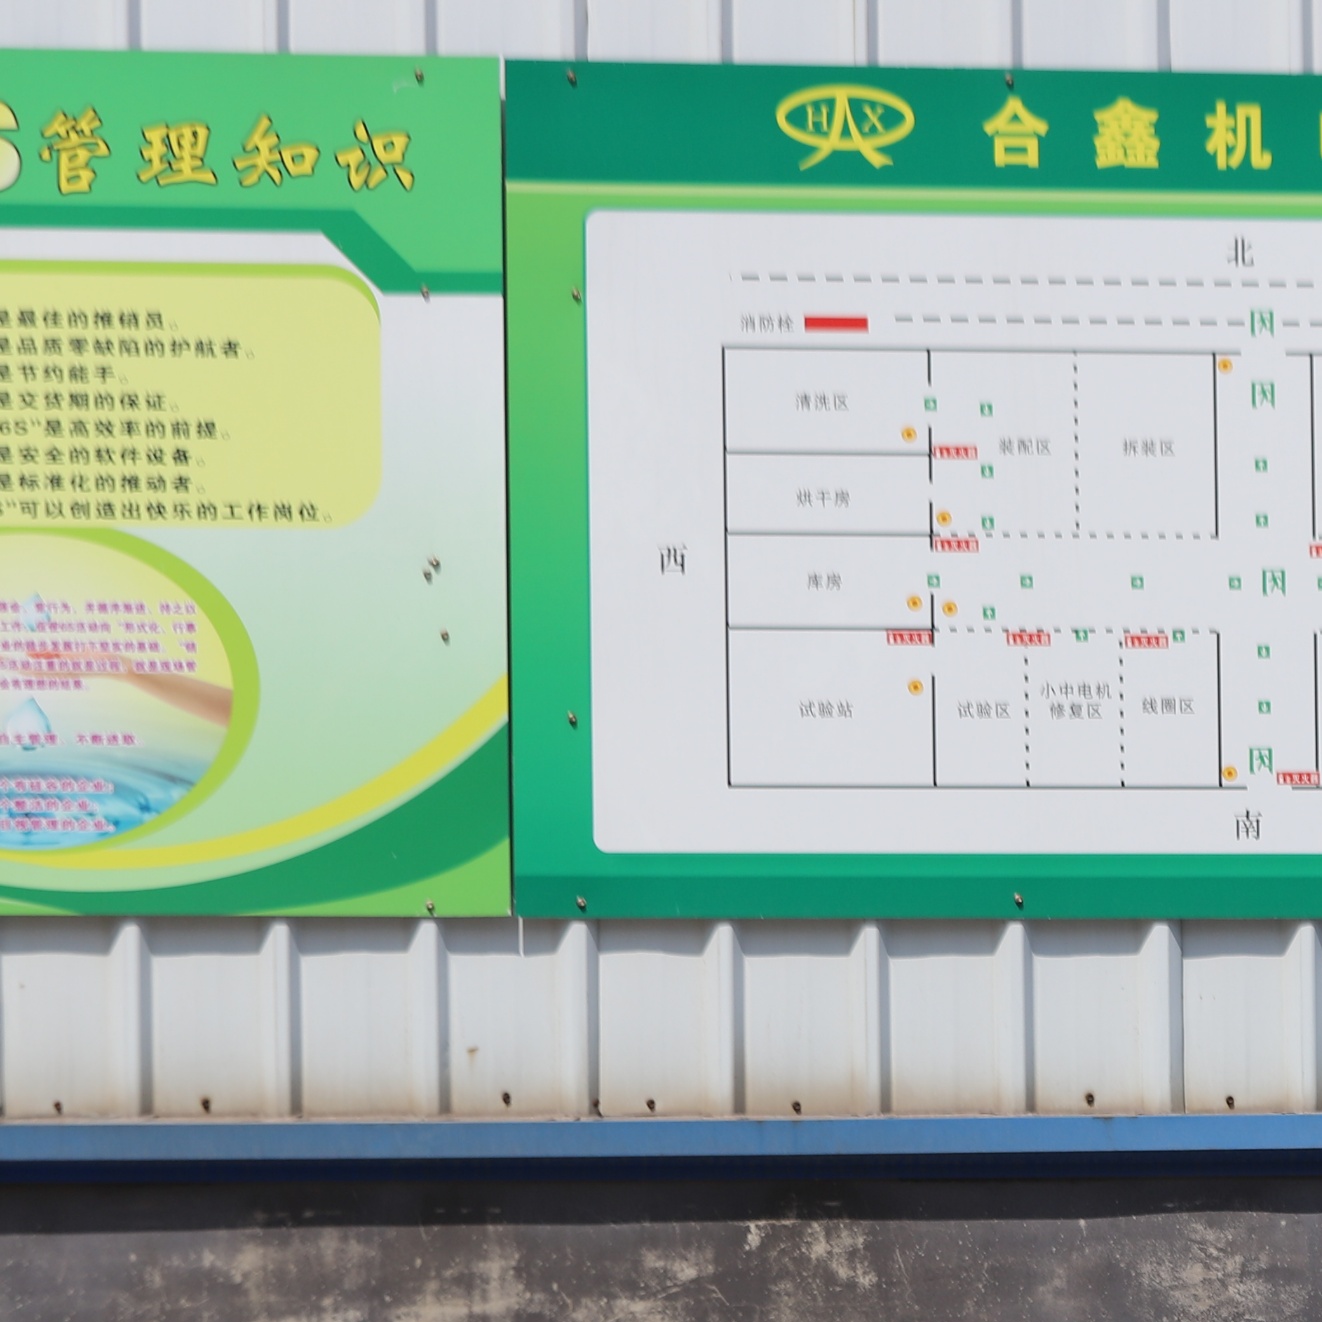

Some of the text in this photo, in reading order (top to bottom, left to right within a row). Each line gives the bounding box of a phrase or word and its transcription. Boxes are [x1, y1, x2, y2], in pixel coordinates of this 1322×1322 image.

[1227, 235, 1255, 268] 北
[741, 313, 794, 333] 消防栓
[796, 391, 849, 411] 清洗区
[999, 437, 1052, 456] 装配区
[658, 543, 688, 575] 西
[808, 572, 843, 591] 库房
[1040, 681, 1113, 700] 小中电机
[1049, 702, 1102, 720] 修复区
[1142, 697, 1195, 715] 线圈区
[1235, 808, 1262, 841] 南
